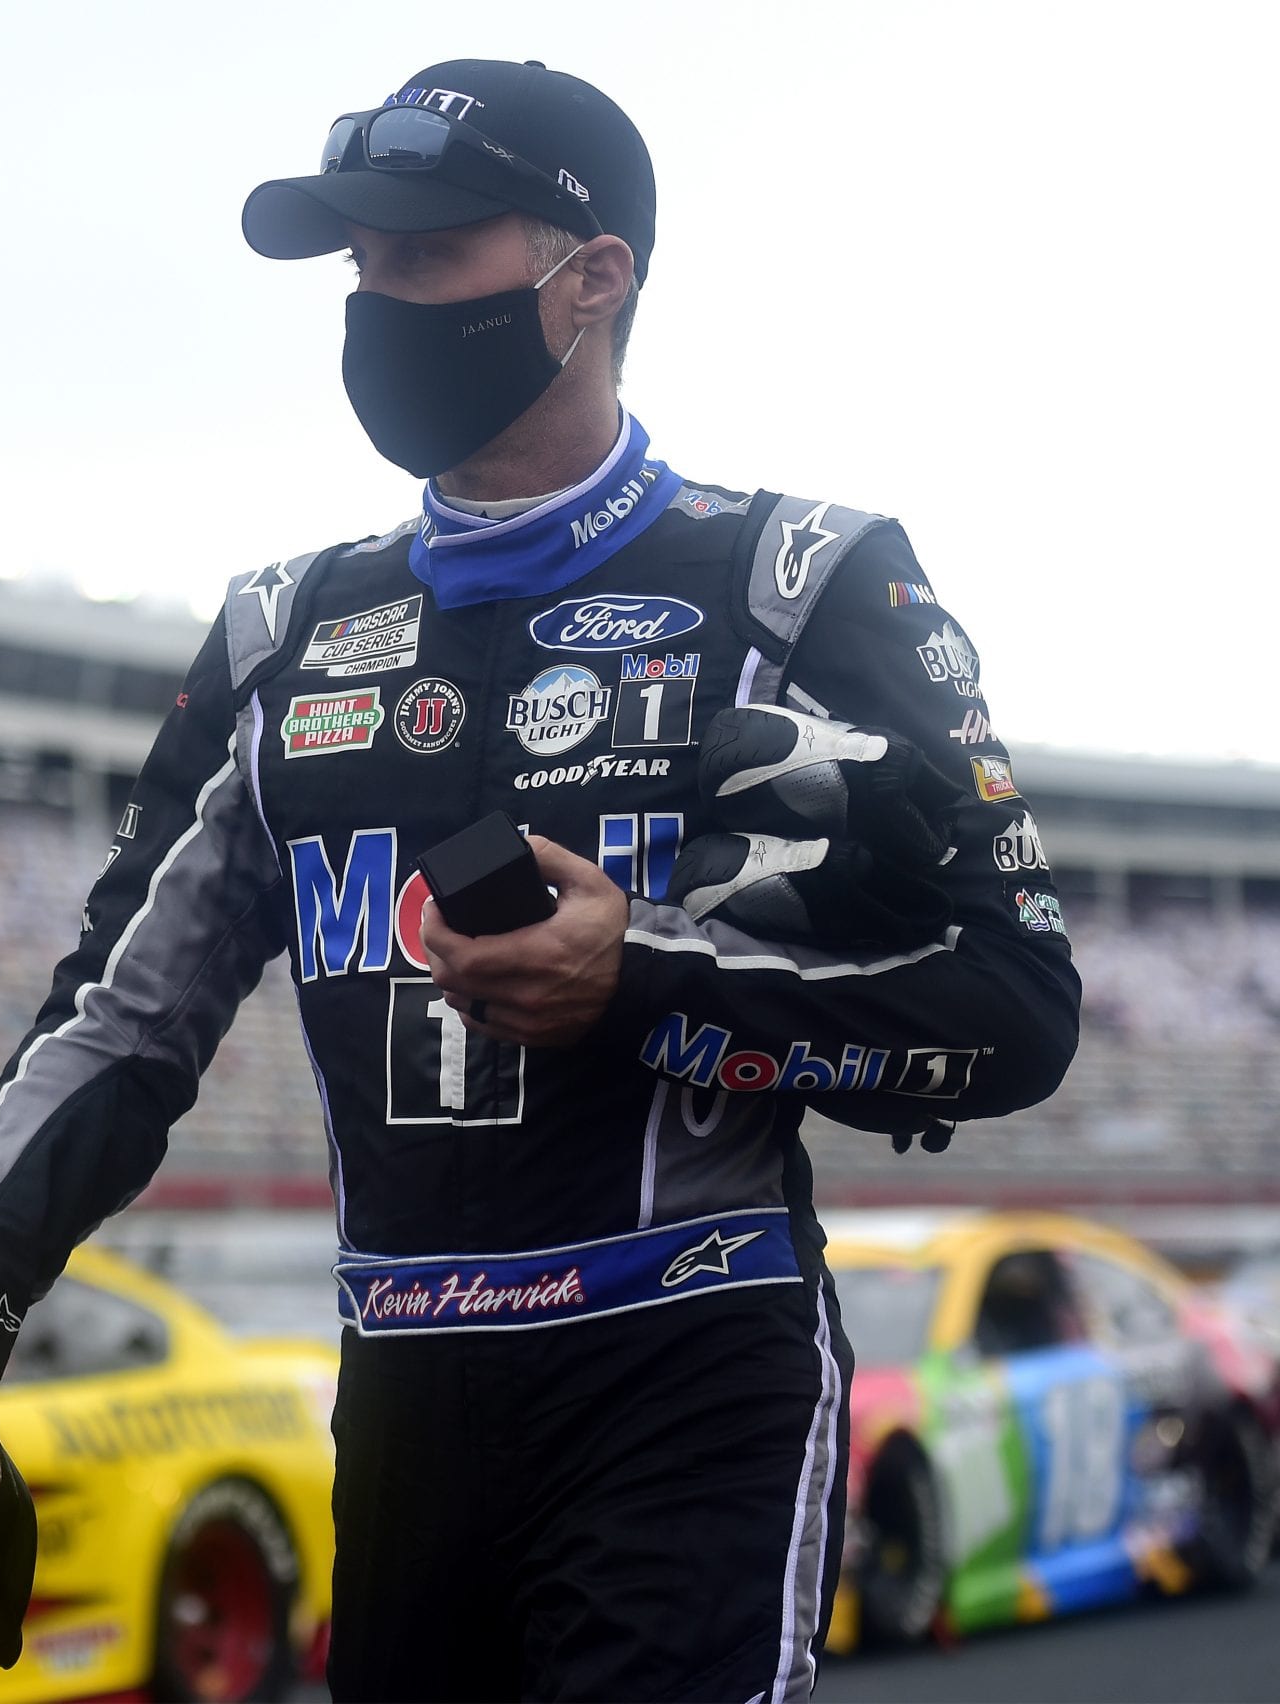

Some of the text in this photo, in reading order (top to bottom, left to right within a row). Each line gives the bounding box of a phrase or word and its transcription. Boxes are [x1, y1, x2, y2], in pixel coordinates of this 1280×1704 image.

[462, 313, 511, 338] JAANUU
[571, 480, 644, 549] Mobil
[349, 604, 408, 634] NASCAR
[560, 602, 670, 642] Ford
[322, 629, 405, 658] CUP SERIES
[344, 656, 401, 674] CHAMPION
[621, 654, 701, 679] Mobil
[400, 683, 430, 716] JIMMY
[953, 680, 984, 699] LIGH
[289, 711, 375, 732] BROTHERS
[309, 699, 357, 717] HUNT
[413, 698, 447, 734] JJ
[509, 690, 610, 728] BUSCH
[639, 684, 665, 740] 1
[305, 727, 354, 746] PIZZA
[528, 722, 586, 742] LIGHT
[639, 1012, 891, 1092] Mobil
[362, 1268, 580, 1319] Kevin Harvick
